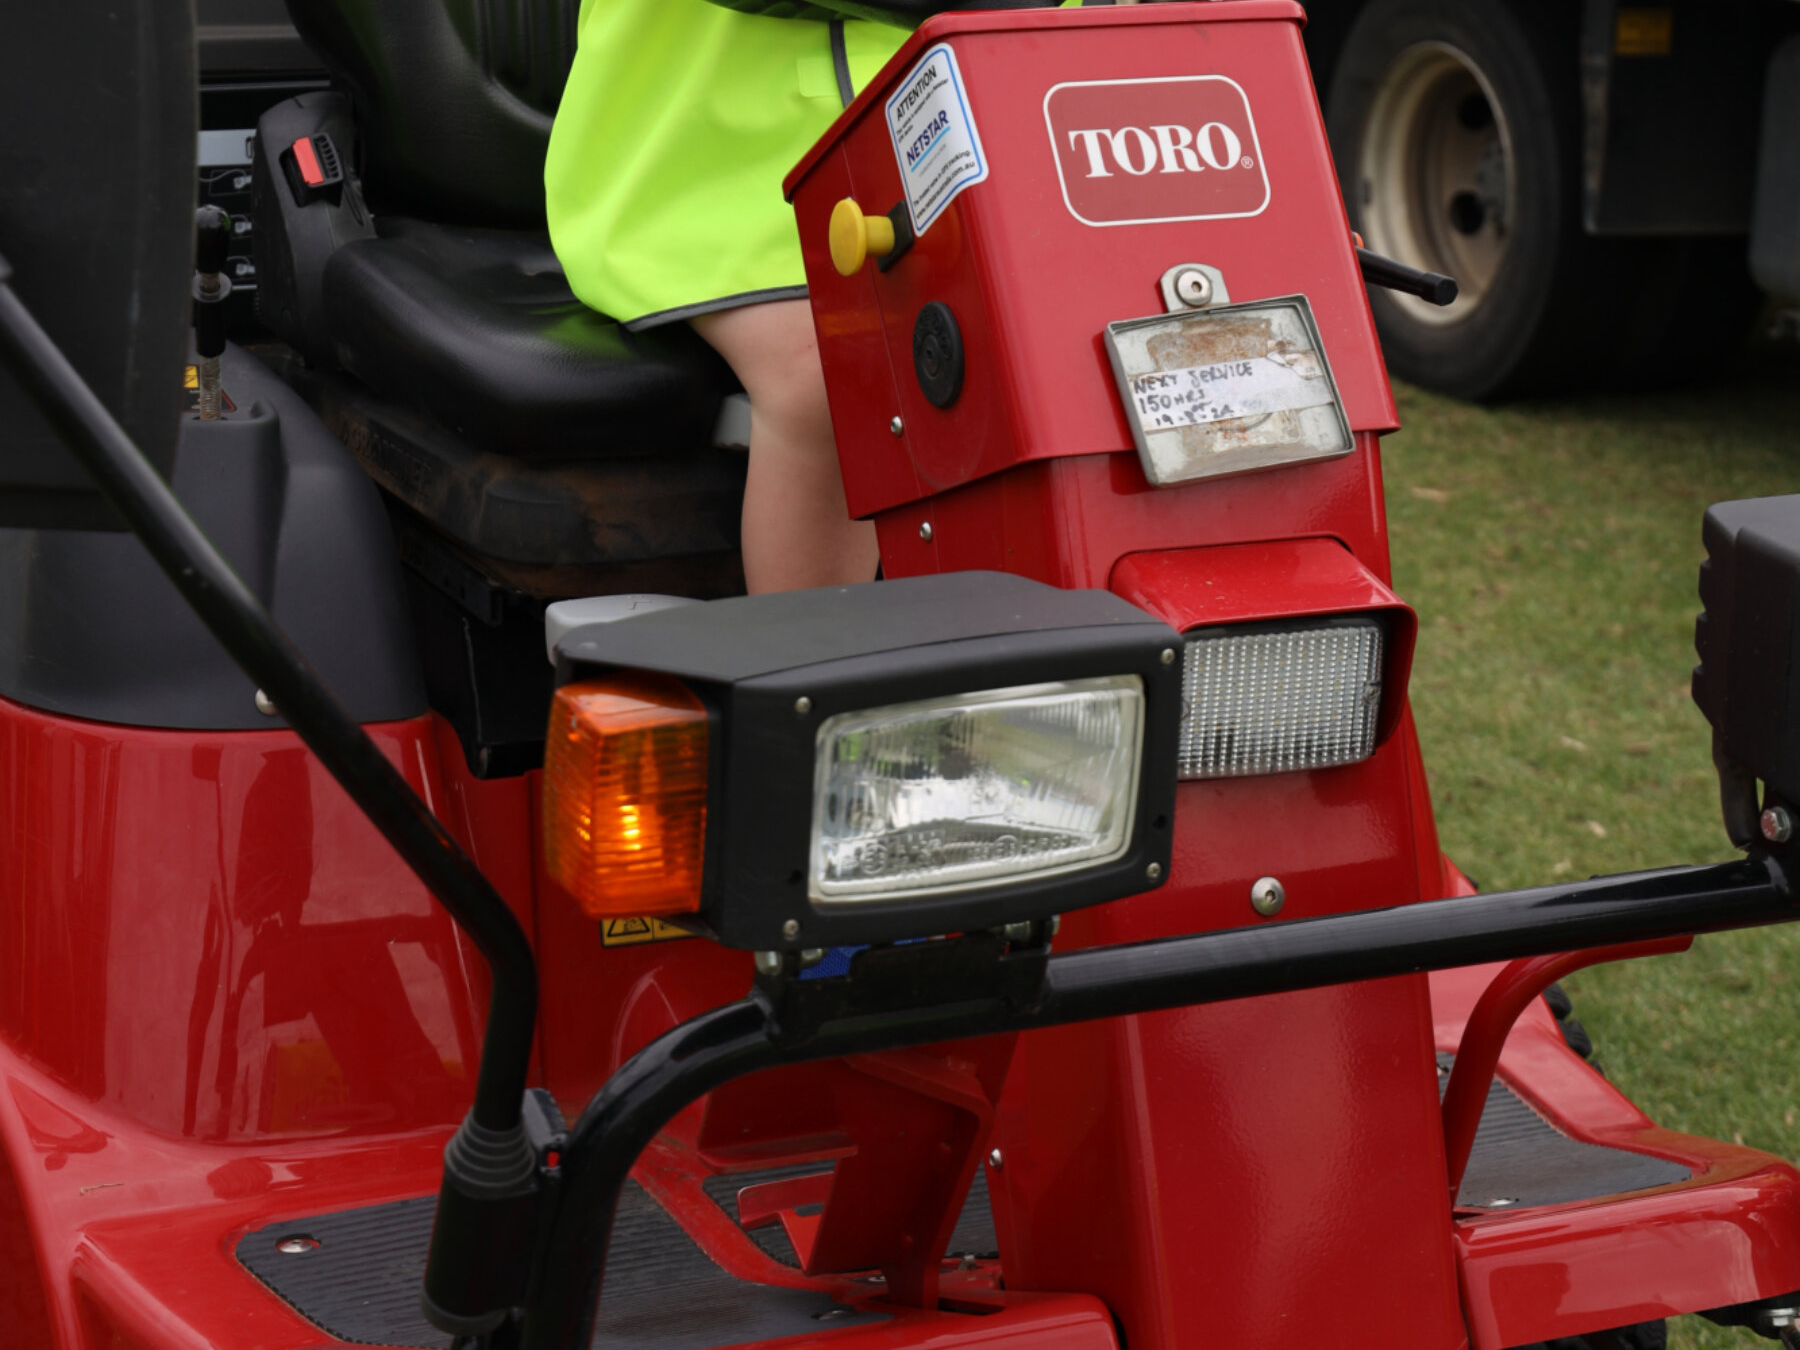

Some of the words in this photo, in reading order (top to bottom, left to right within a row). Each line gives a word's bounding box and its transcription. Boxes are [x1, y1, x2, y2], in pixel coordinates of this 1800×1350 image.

[896, 64, 937, 122] ATTENTION
[906, 109, 949, 166] NETSTAR
[1068, 122, 1241, 178] TORO
